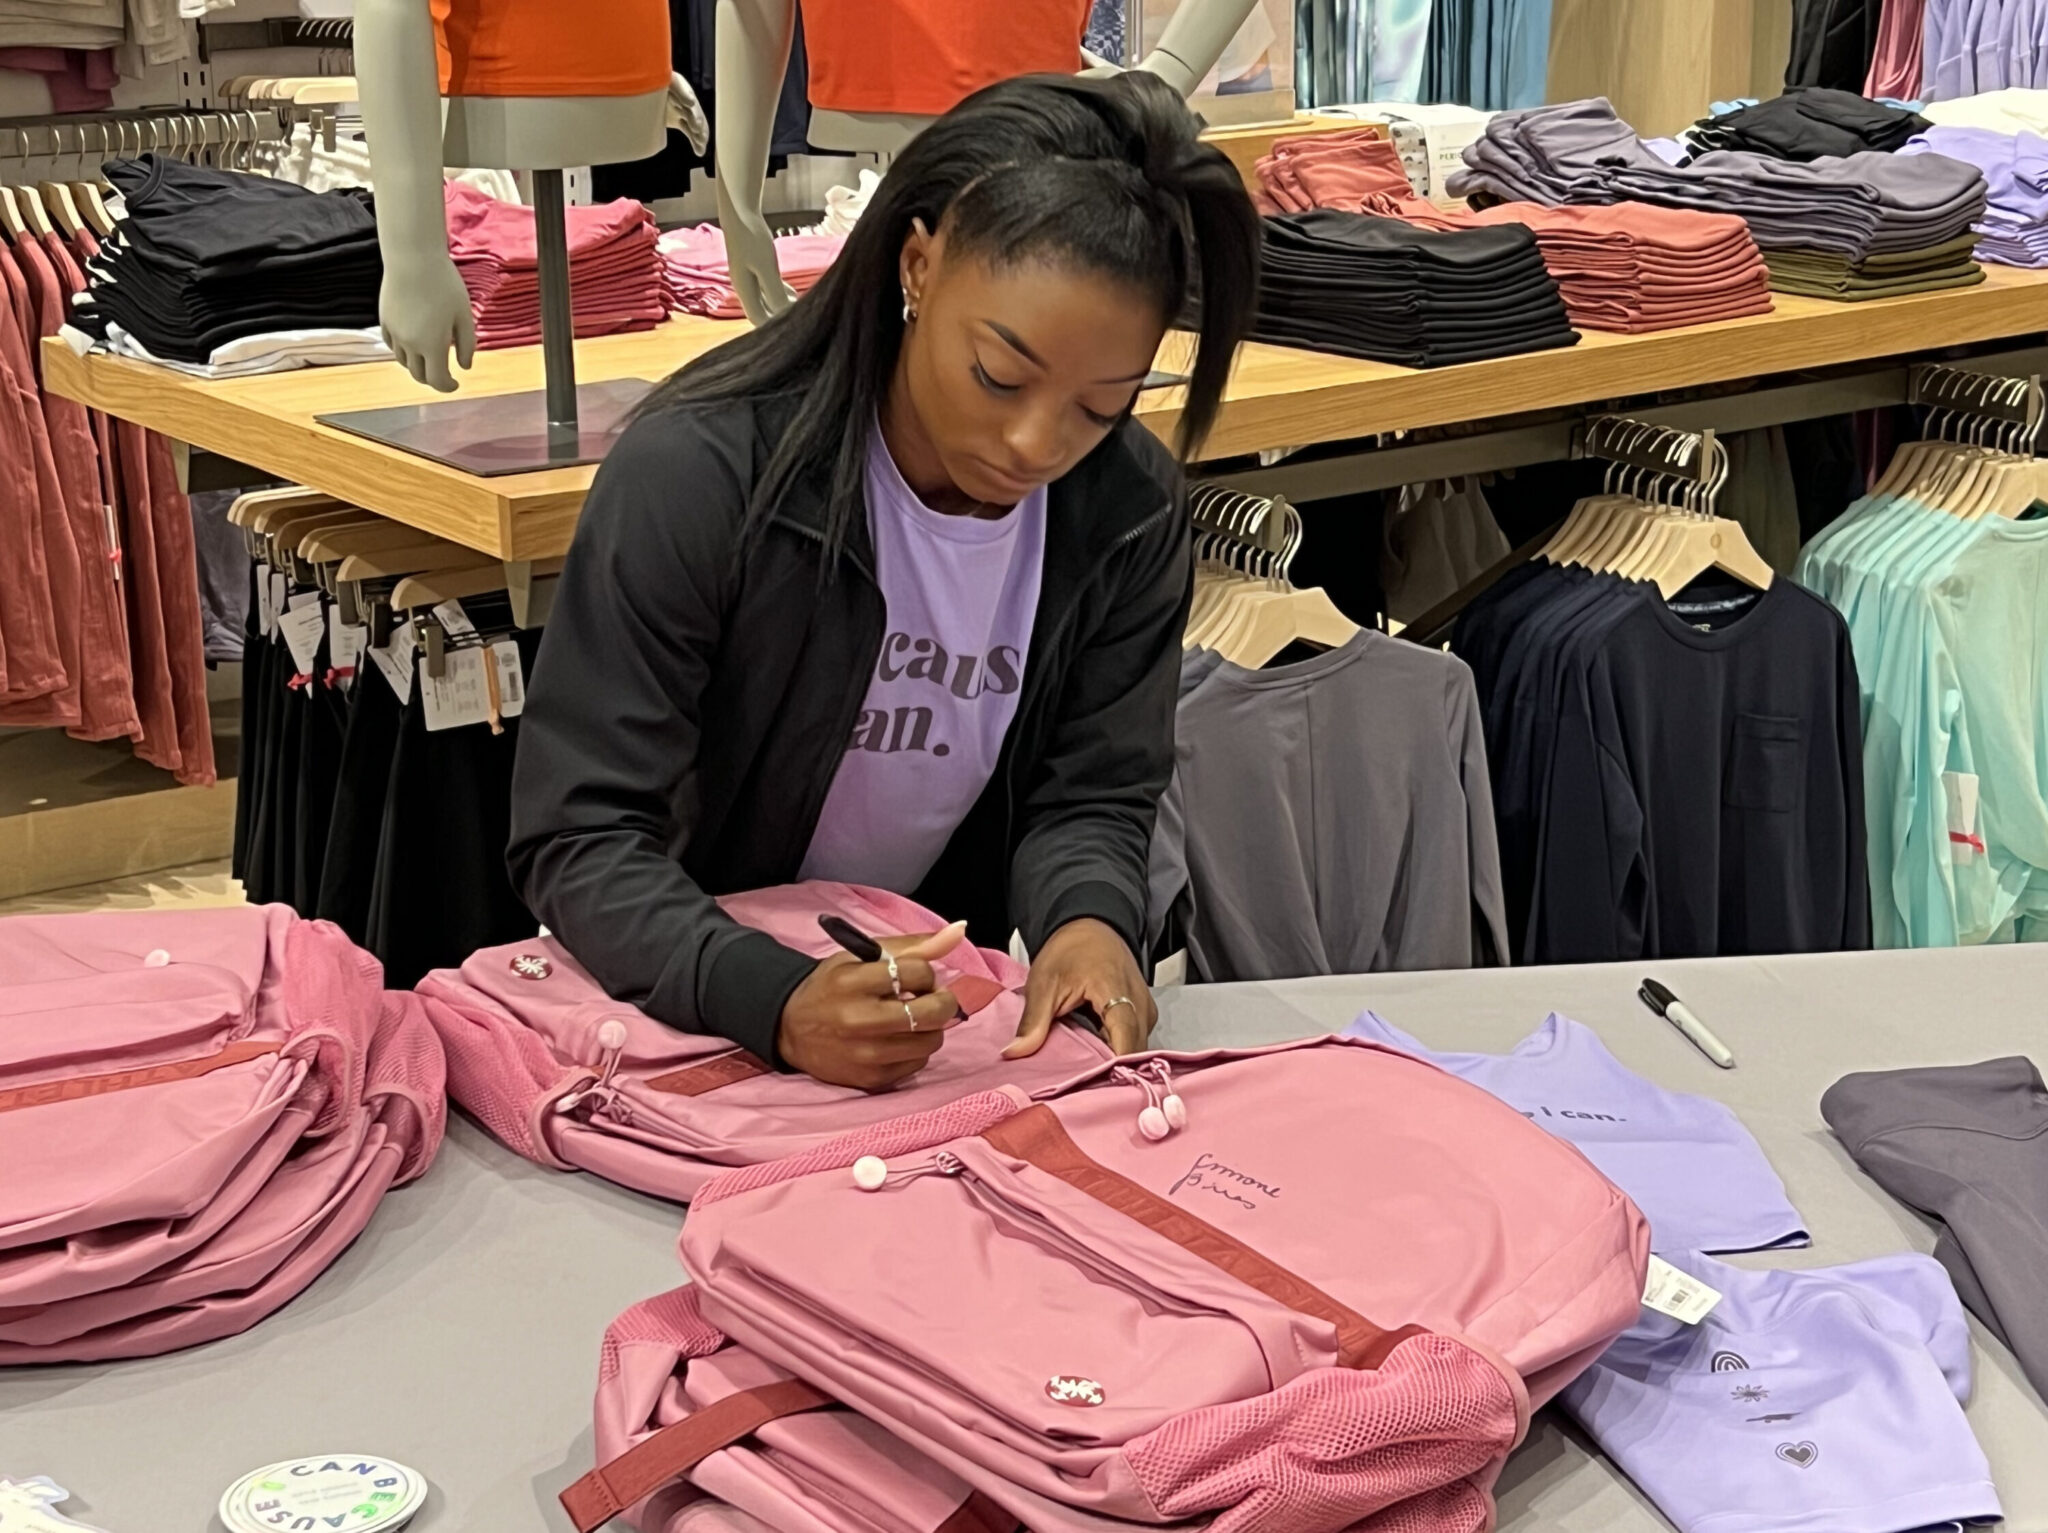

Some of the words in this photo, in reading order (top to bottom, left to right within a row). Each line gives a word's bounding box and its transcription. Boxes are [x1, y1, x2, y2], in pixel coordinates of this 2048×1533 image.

[878, 631, 1021, 700] caus
[847, 706, 950, 757] an.
[1560, 1109, 1628, 1122] can.
[290, 1461, 377, 1477] CAN
